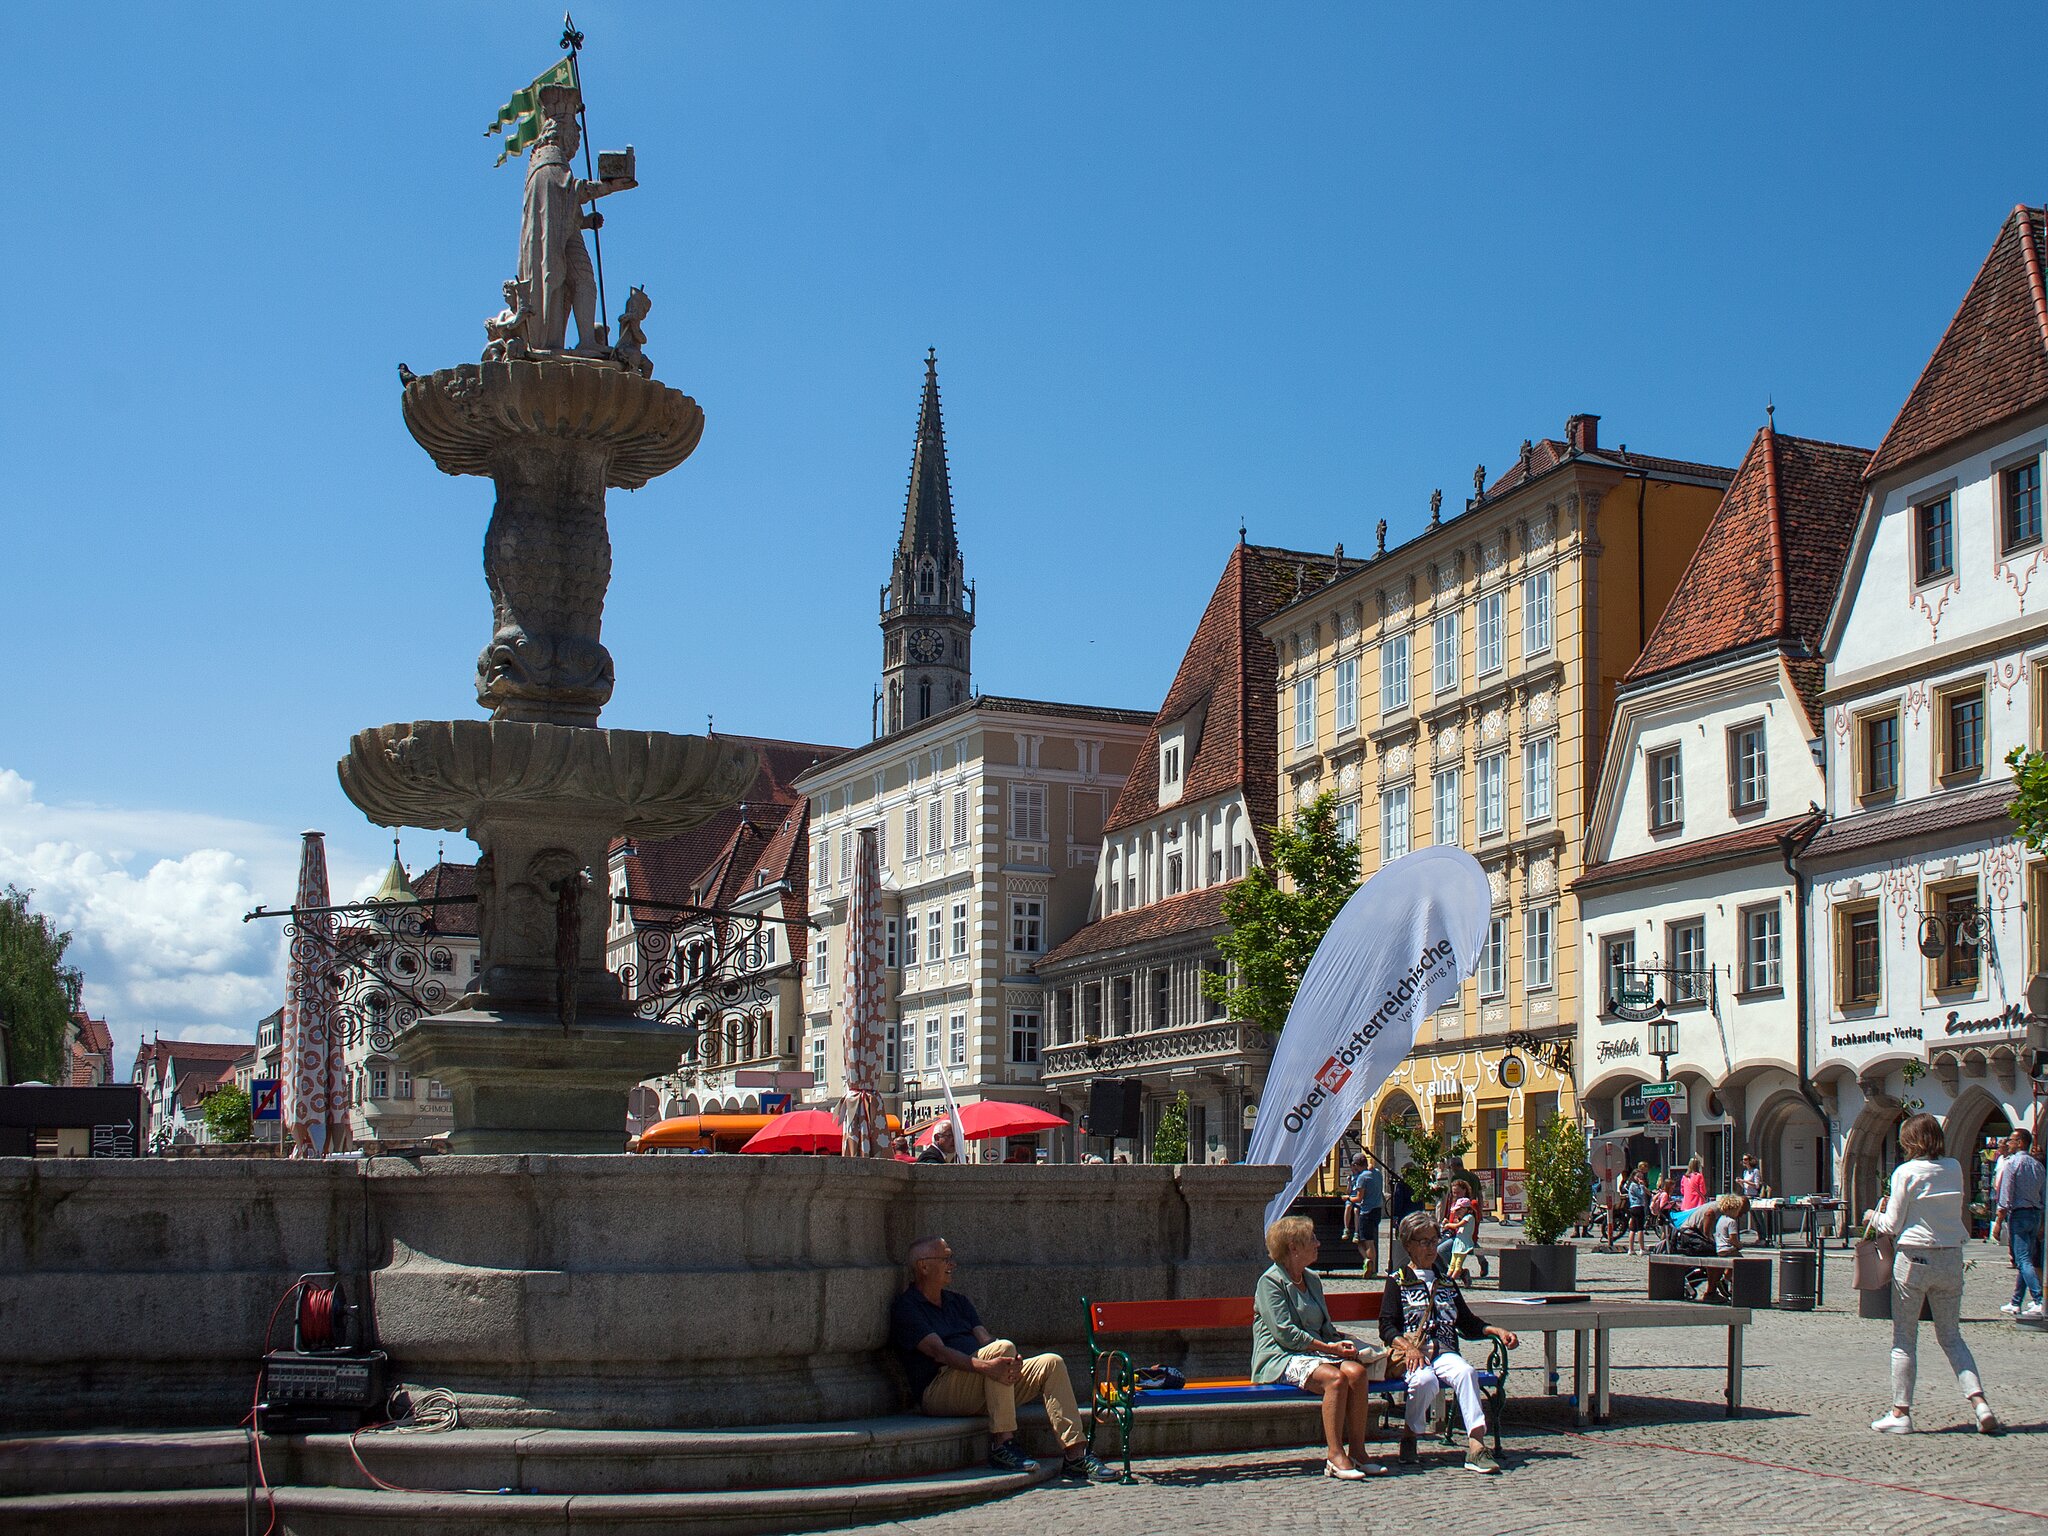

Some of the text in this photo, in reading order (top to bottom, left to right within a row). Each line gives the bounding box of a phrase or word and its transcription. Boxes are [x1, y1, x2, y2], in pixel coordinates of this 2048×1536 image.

[1397, 967, 1447, 1023] Versicherung
[1284, 939, 1453, 1134] Ober österreichische
[1831, 1026, 1923, 1047] Buchhandlung-Verlag
[1429, 1079, 1458, 1097] BILLA
